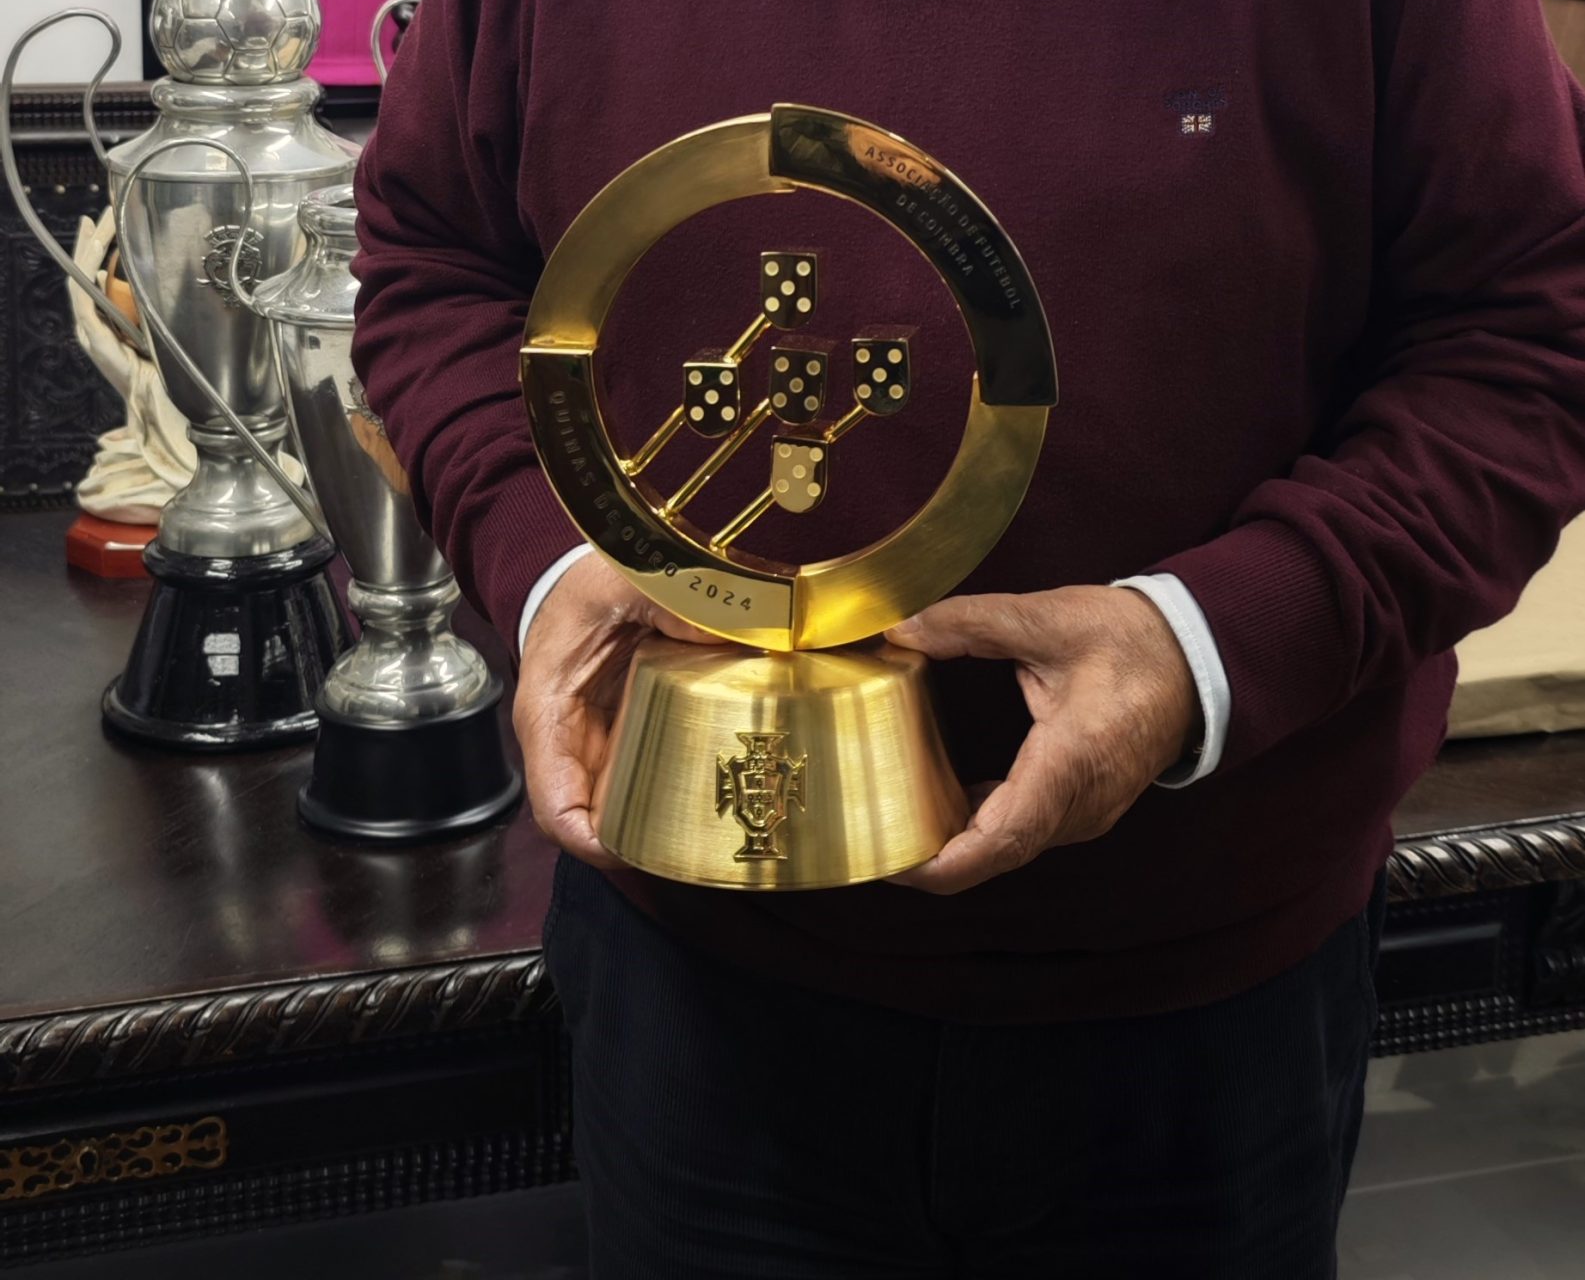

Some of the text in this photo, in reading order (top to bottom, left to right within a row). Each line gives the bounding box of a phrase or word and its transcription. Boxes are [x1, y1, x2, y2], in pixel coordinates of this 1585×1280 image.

[865, 146, 1022, 310] ASSOCIAÇÃO DE FUTEBOL
[895, 193, 975, 277] DE COIMBRA
[593, 493, 621, 525] DE
[621, 526, 679, 578] OURO
[689, 575, 753, 612] 2024
